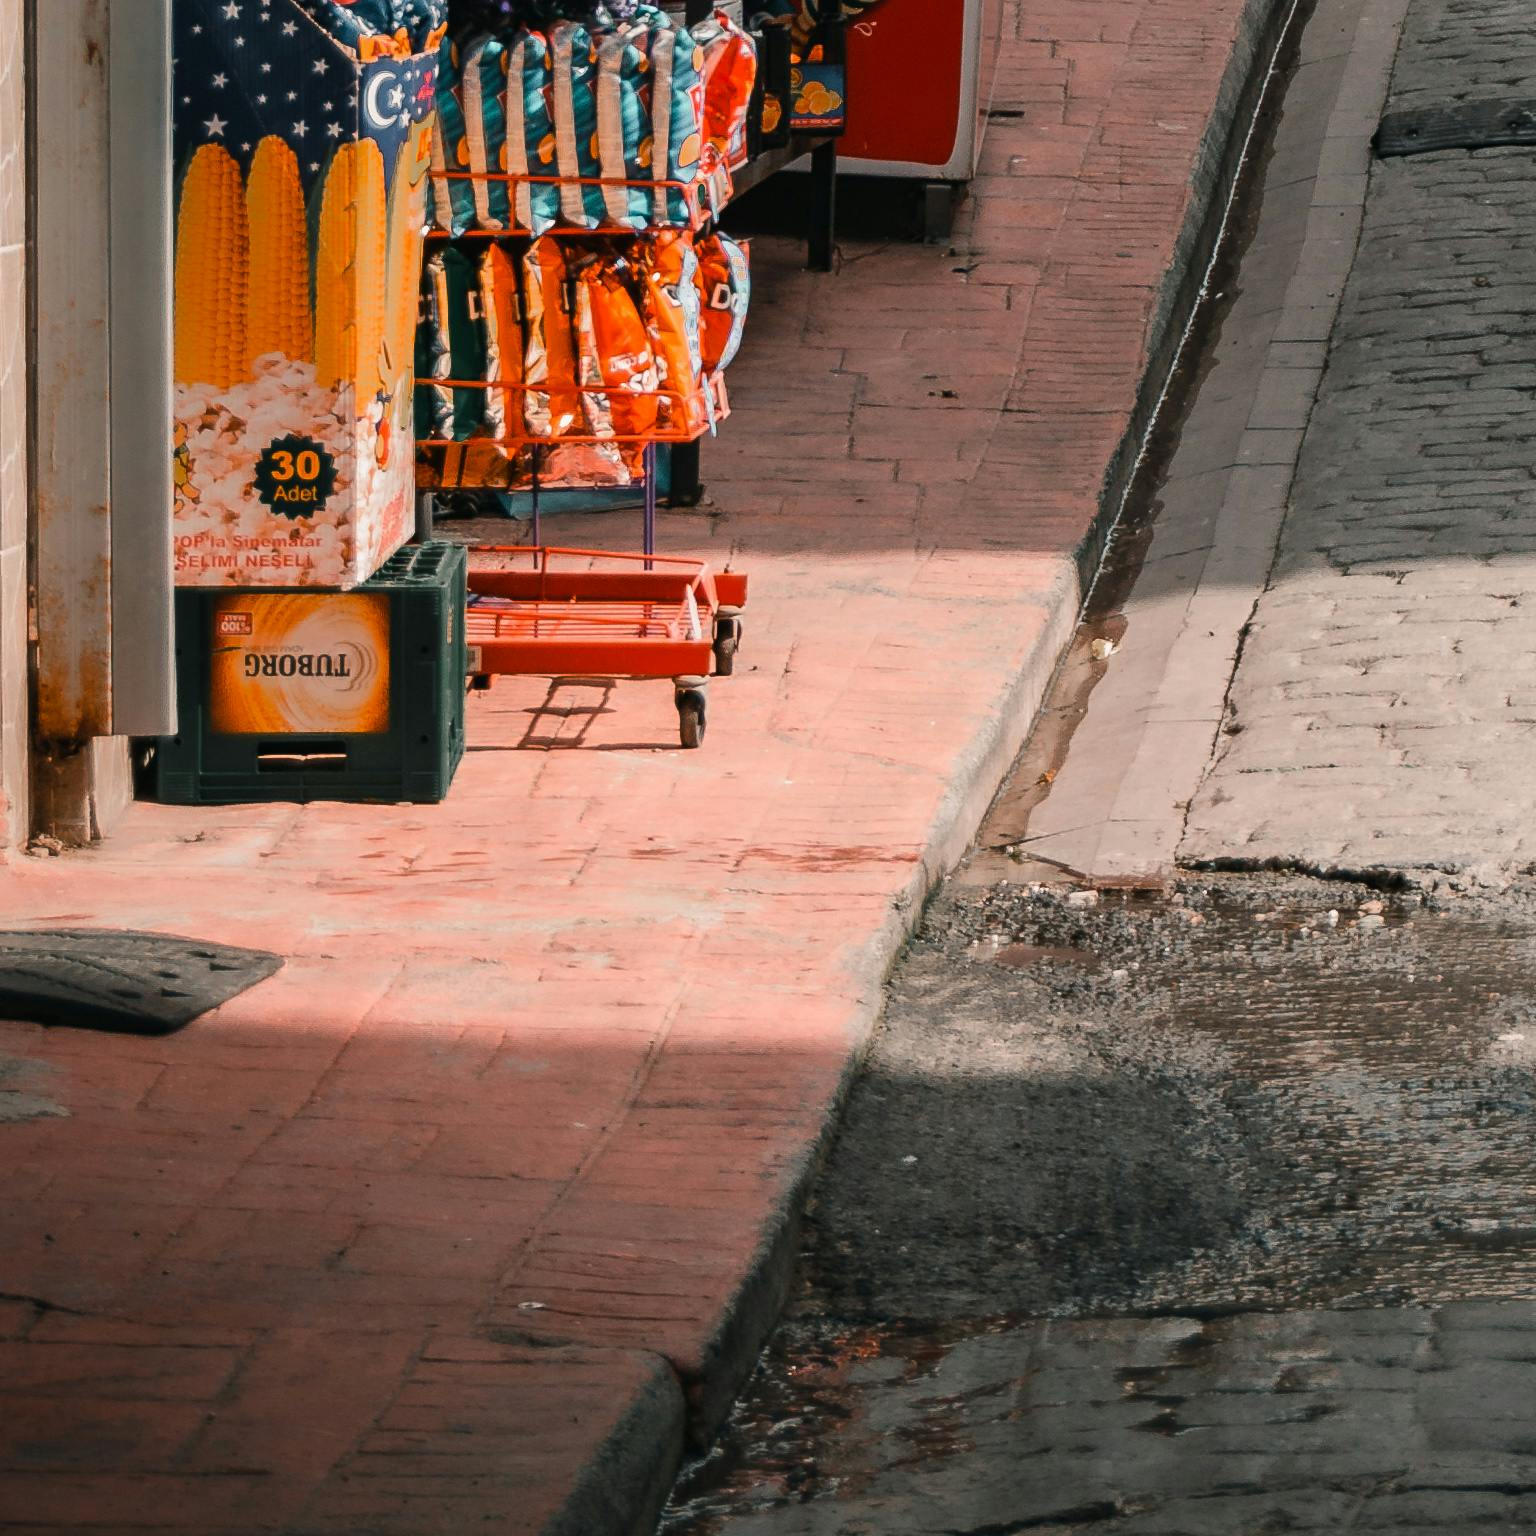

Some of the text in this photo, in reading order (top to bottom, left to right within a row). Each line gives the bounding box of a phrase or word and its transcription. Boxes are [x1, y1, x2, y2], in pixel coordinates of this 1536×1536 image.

[271, 450, 320, 480] 30
[273, 485, 318, 502] Adet
[244, 653, 350, 678] TUBORG
